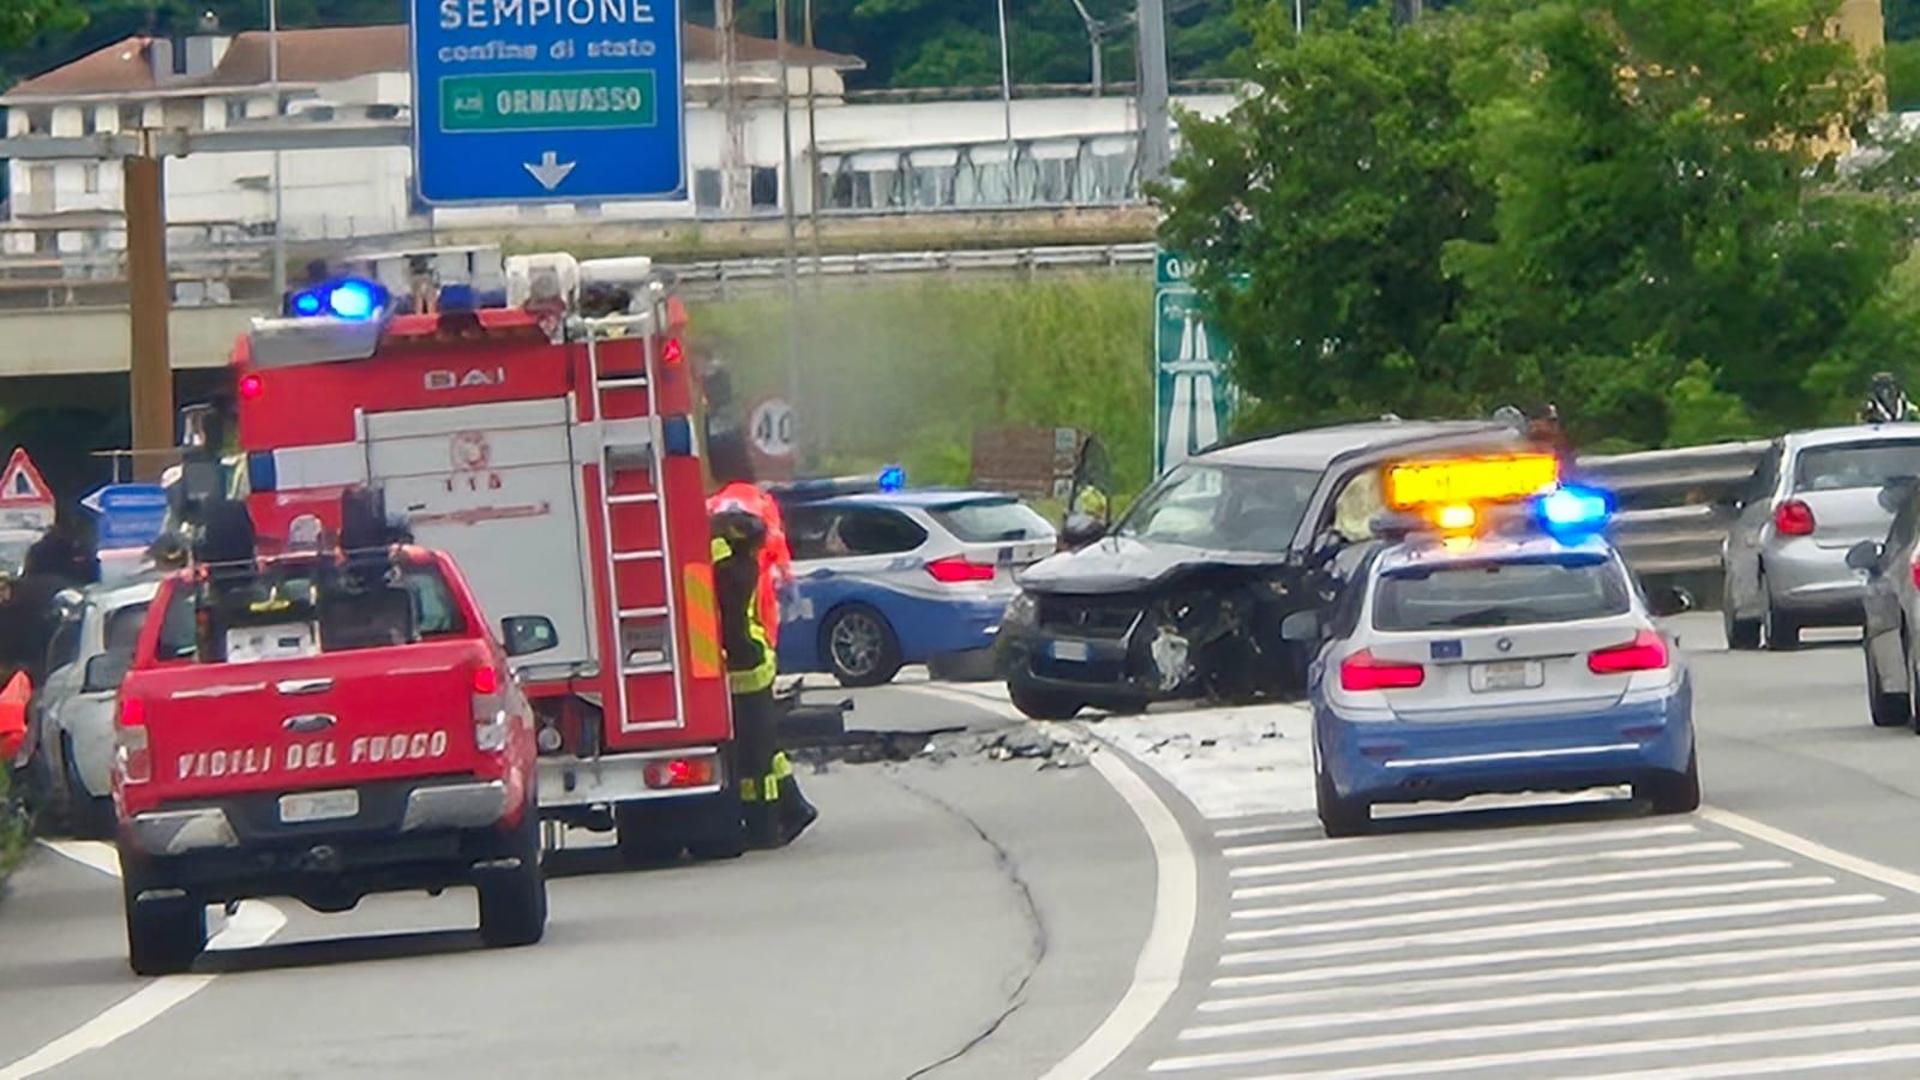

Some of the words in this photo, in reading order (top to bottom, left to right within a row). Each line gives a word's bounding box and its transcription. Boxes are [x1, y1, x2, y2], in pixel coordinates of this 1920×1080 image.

[440, 0, 655, 29] SEMPIONE
[550, 39, 574, 59] di
[587, 38, 656, 58] stato
[497, 86, 641, 115] ORNAVASSO
[178, 745, 271, 779] VIGILI
[286, 742, 336, 769] DEL
[351, 730, 447, 763] FUOCO
